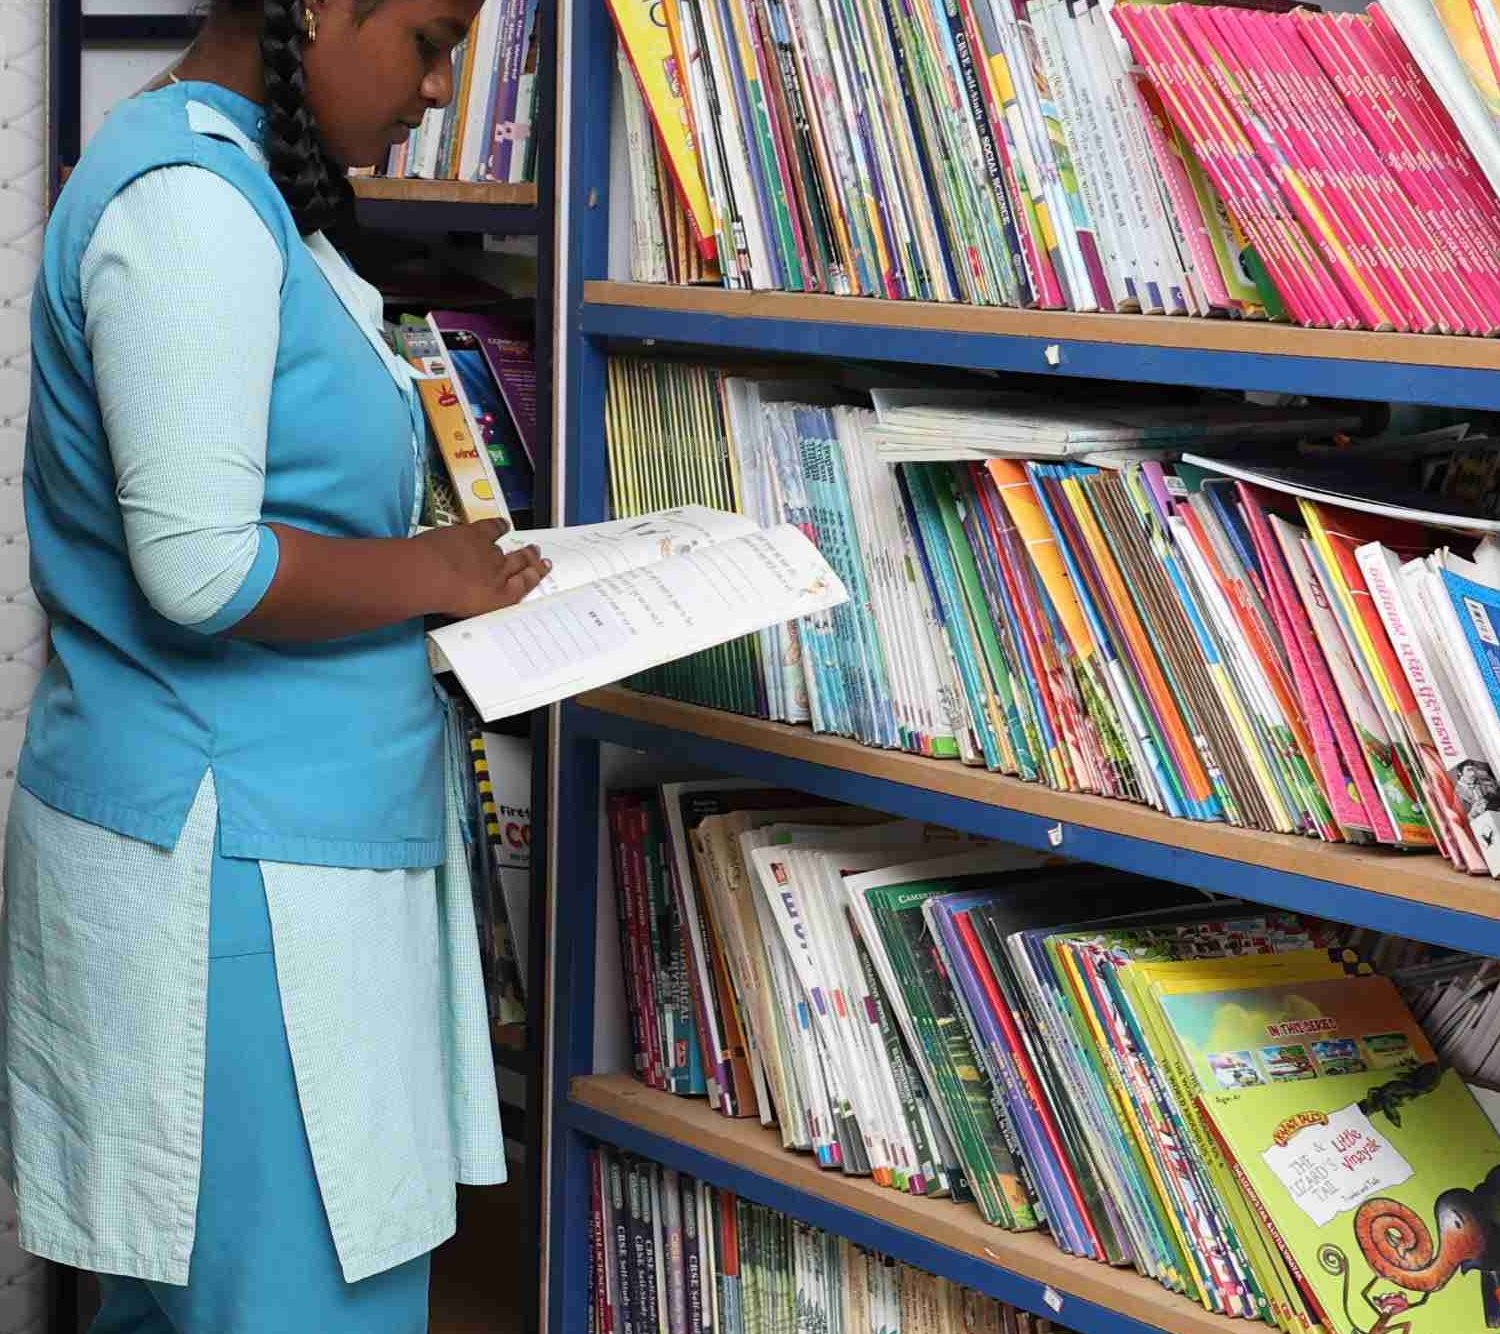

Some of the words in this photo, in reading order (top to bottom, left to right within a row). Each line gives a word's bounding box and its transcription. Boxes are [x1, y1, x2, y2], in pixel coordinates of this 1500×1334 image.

[955, 33, 971, 68] CBSE
[982, 134, 997, 177] SOCIAL
[1332, 1129, 1362, 1155] Little
